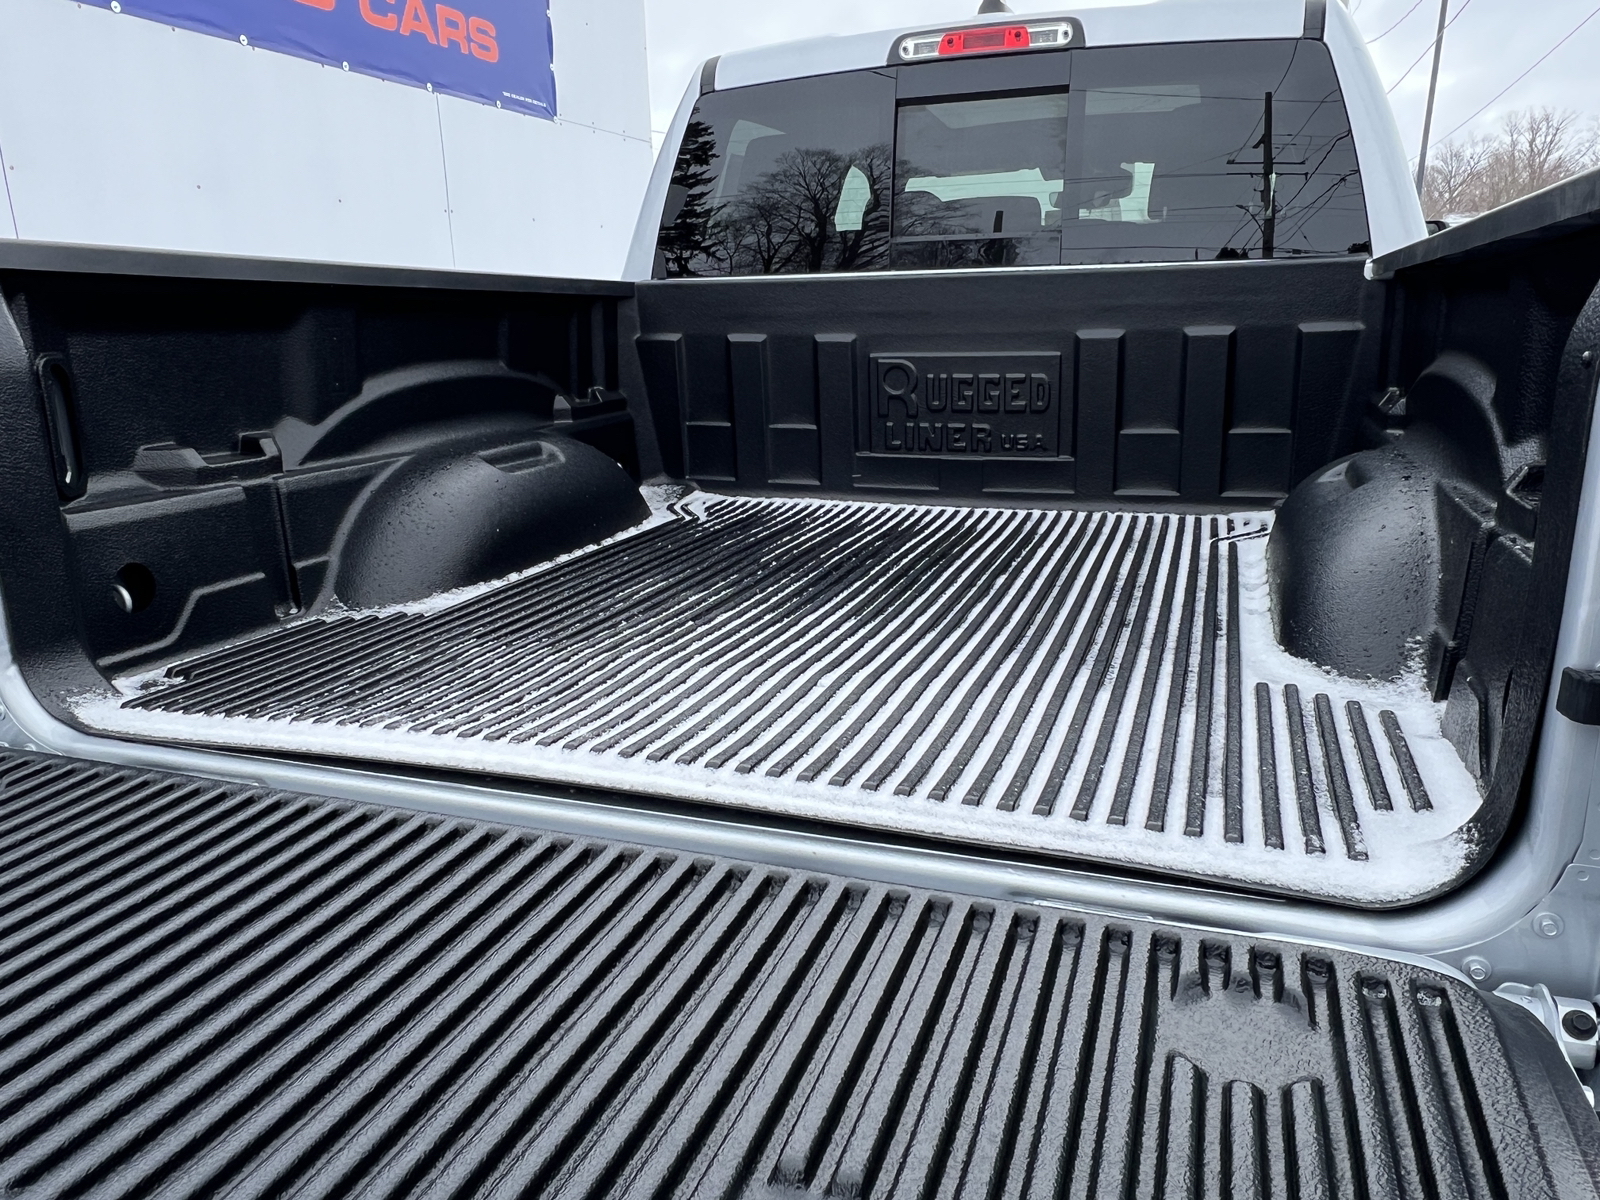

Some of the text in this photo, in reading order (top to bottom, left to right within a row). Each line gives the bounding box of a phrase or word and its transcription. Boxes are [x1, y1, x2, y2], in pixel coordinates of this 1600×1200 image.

[359, 0, 499, 63] CARS
[877, 358, 1050, 418] RUGGED
[885, 421, 1048, 453] LINER USA
